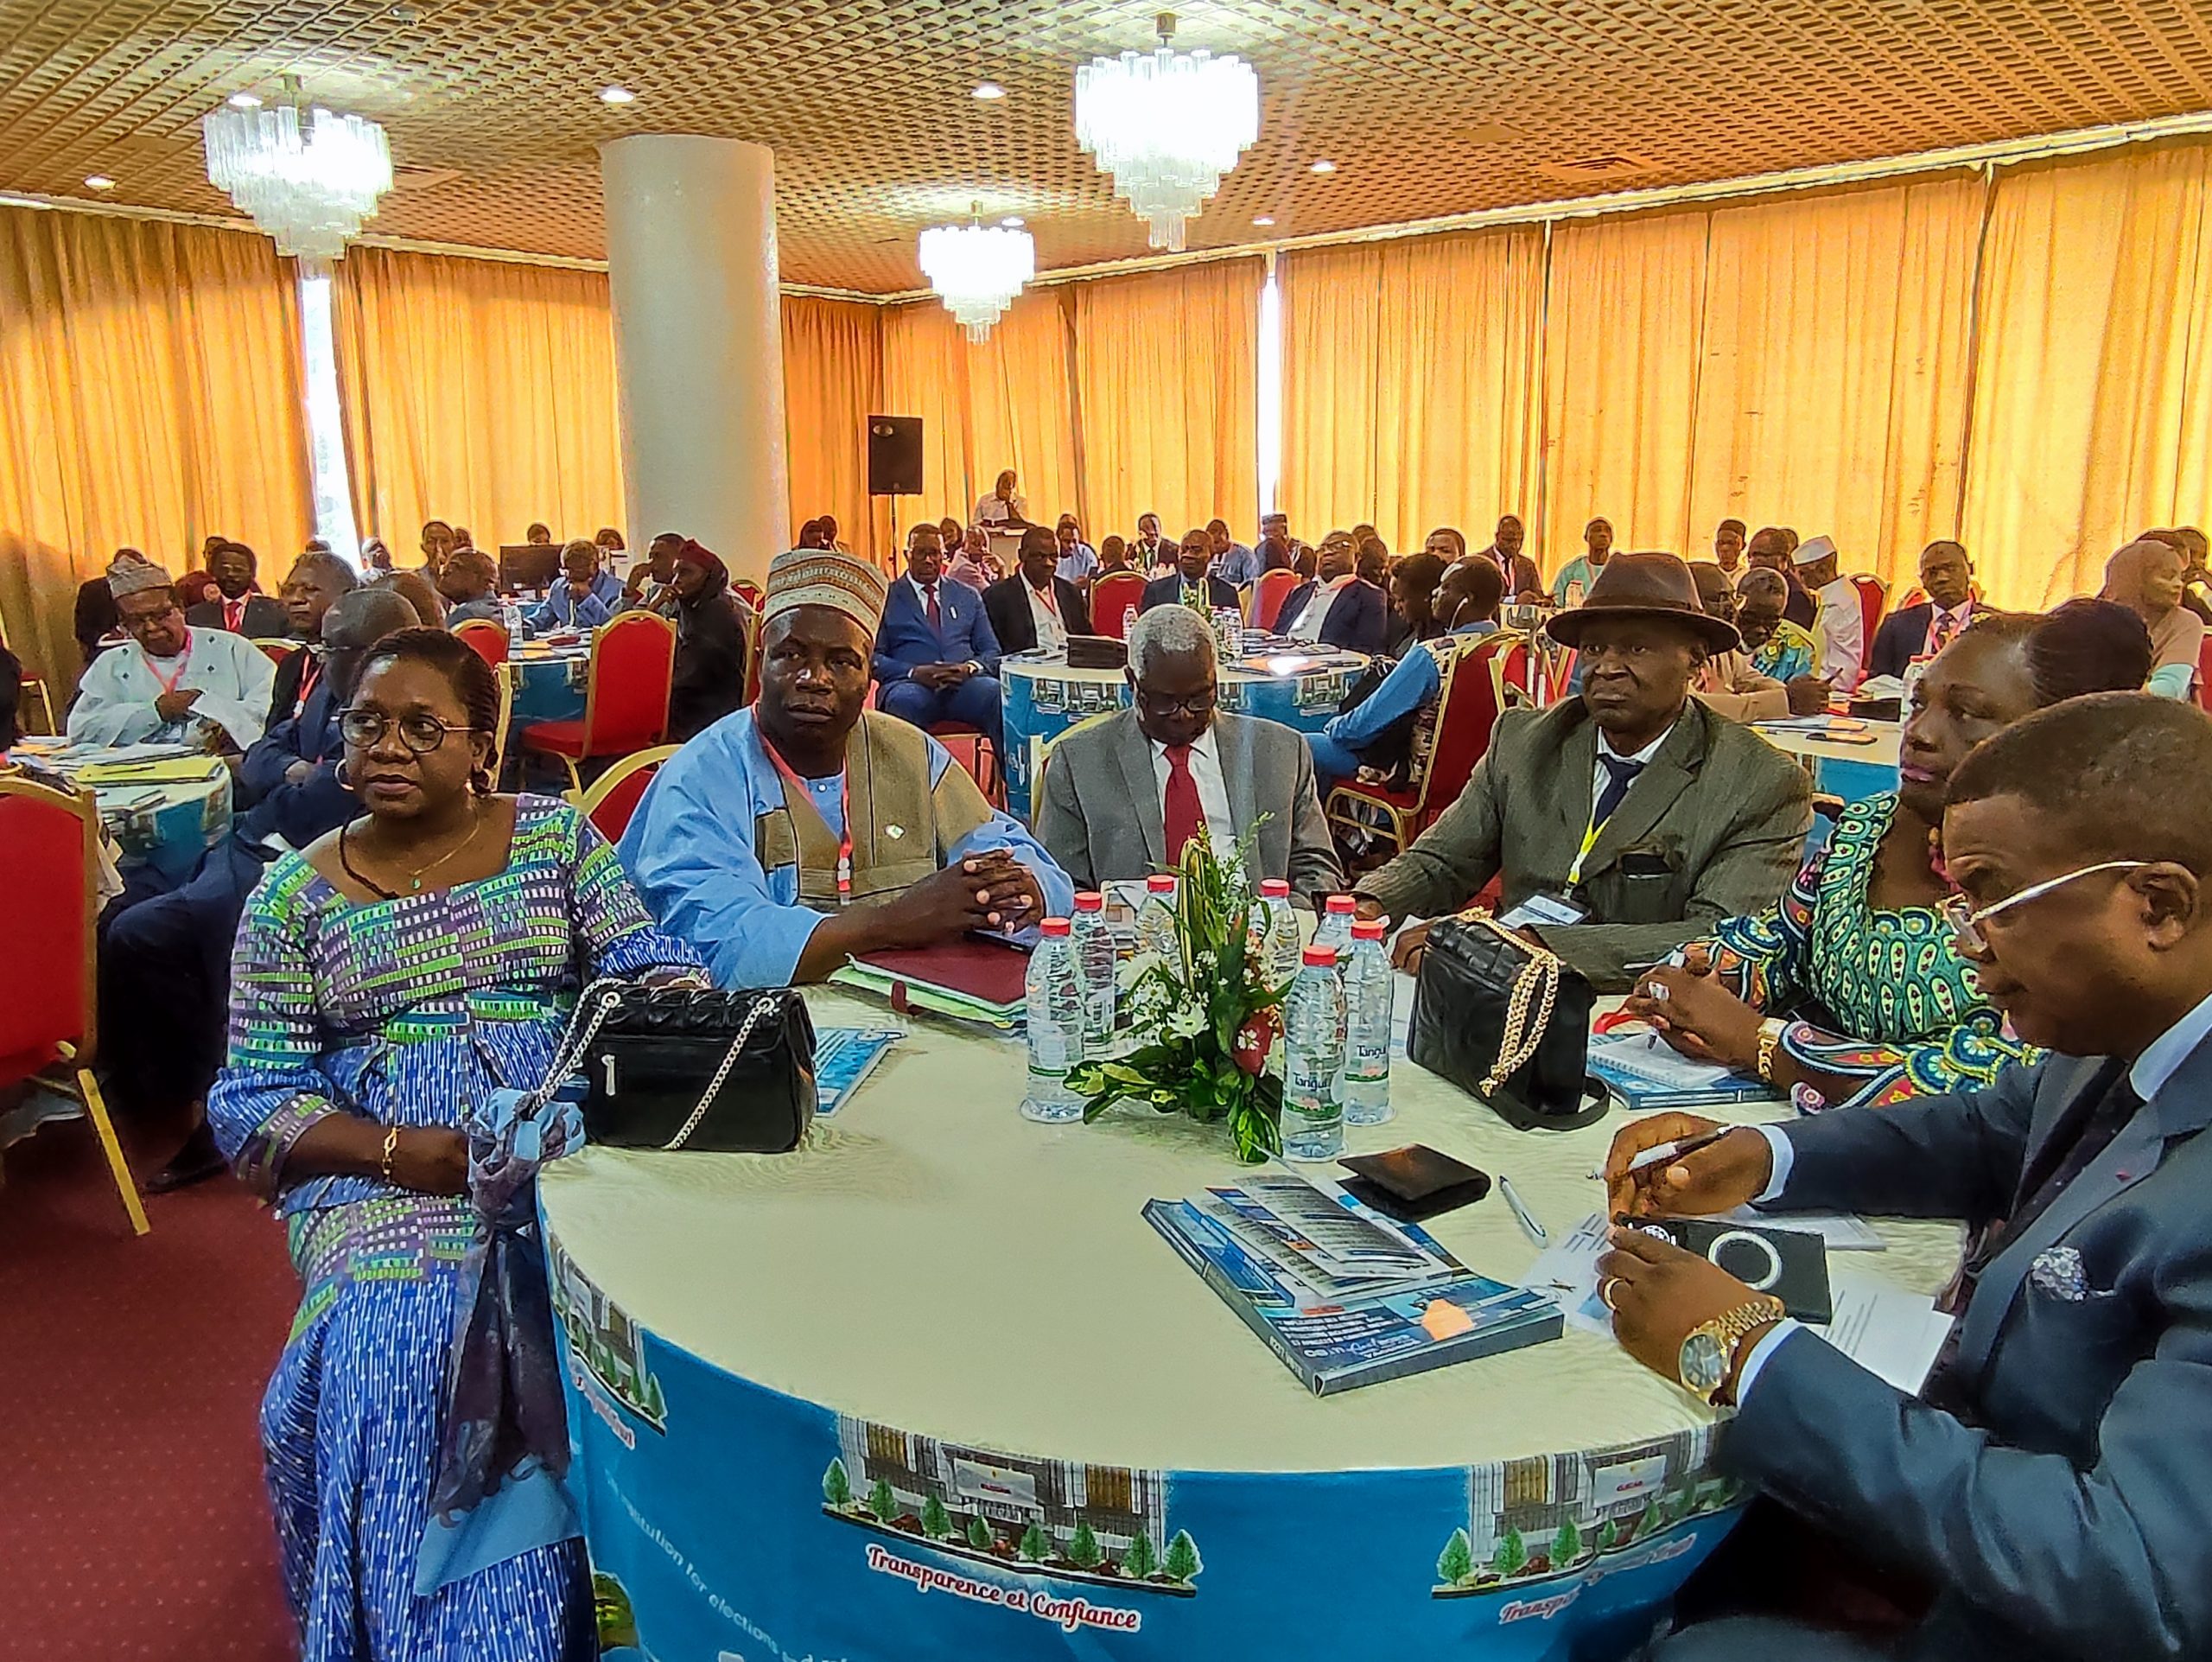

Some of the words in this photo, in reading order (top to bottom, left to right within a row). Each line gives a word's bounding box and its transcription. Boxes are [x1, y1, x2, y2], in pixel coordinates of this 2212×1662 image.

[868, 1545, 1001, 1602] Transparence
[1007, 1592, 1027, 1608] et
[1032, 1595, 1139, 1629] Confiance
